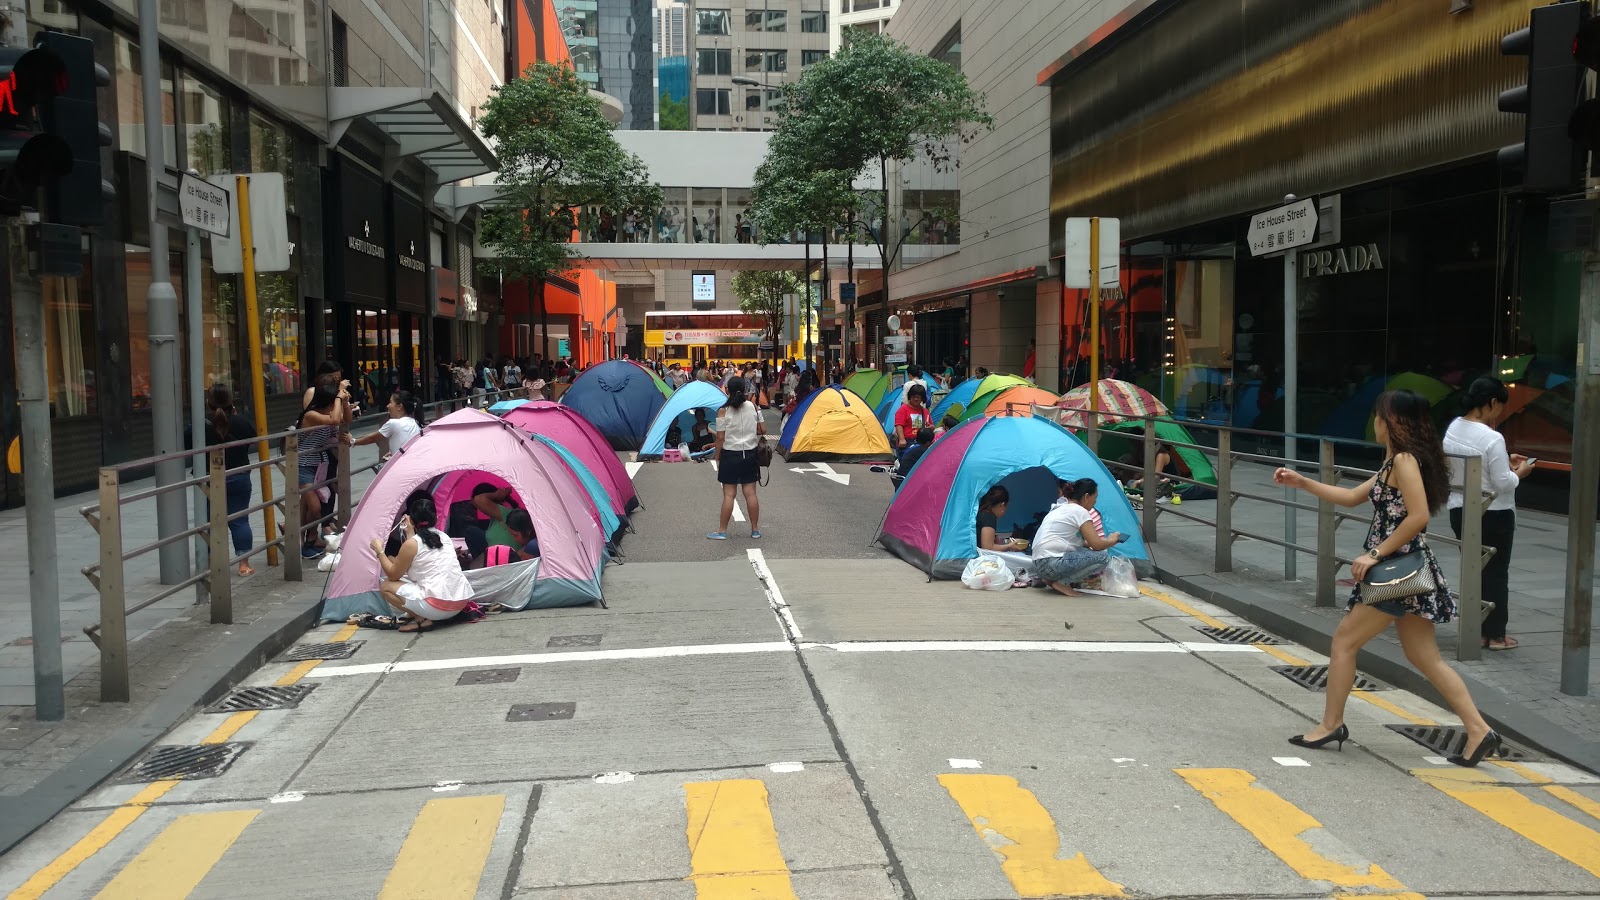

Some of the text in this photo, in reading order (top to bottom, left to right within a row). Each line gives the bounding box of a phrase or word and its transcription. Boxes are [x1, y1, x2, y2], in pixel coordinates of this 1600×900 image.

[187, 182, 223, 207] Ice House Street
[1256, 206, 1307, 230] Ice House Street
[1302, 243, 1384, 278] PRADA
